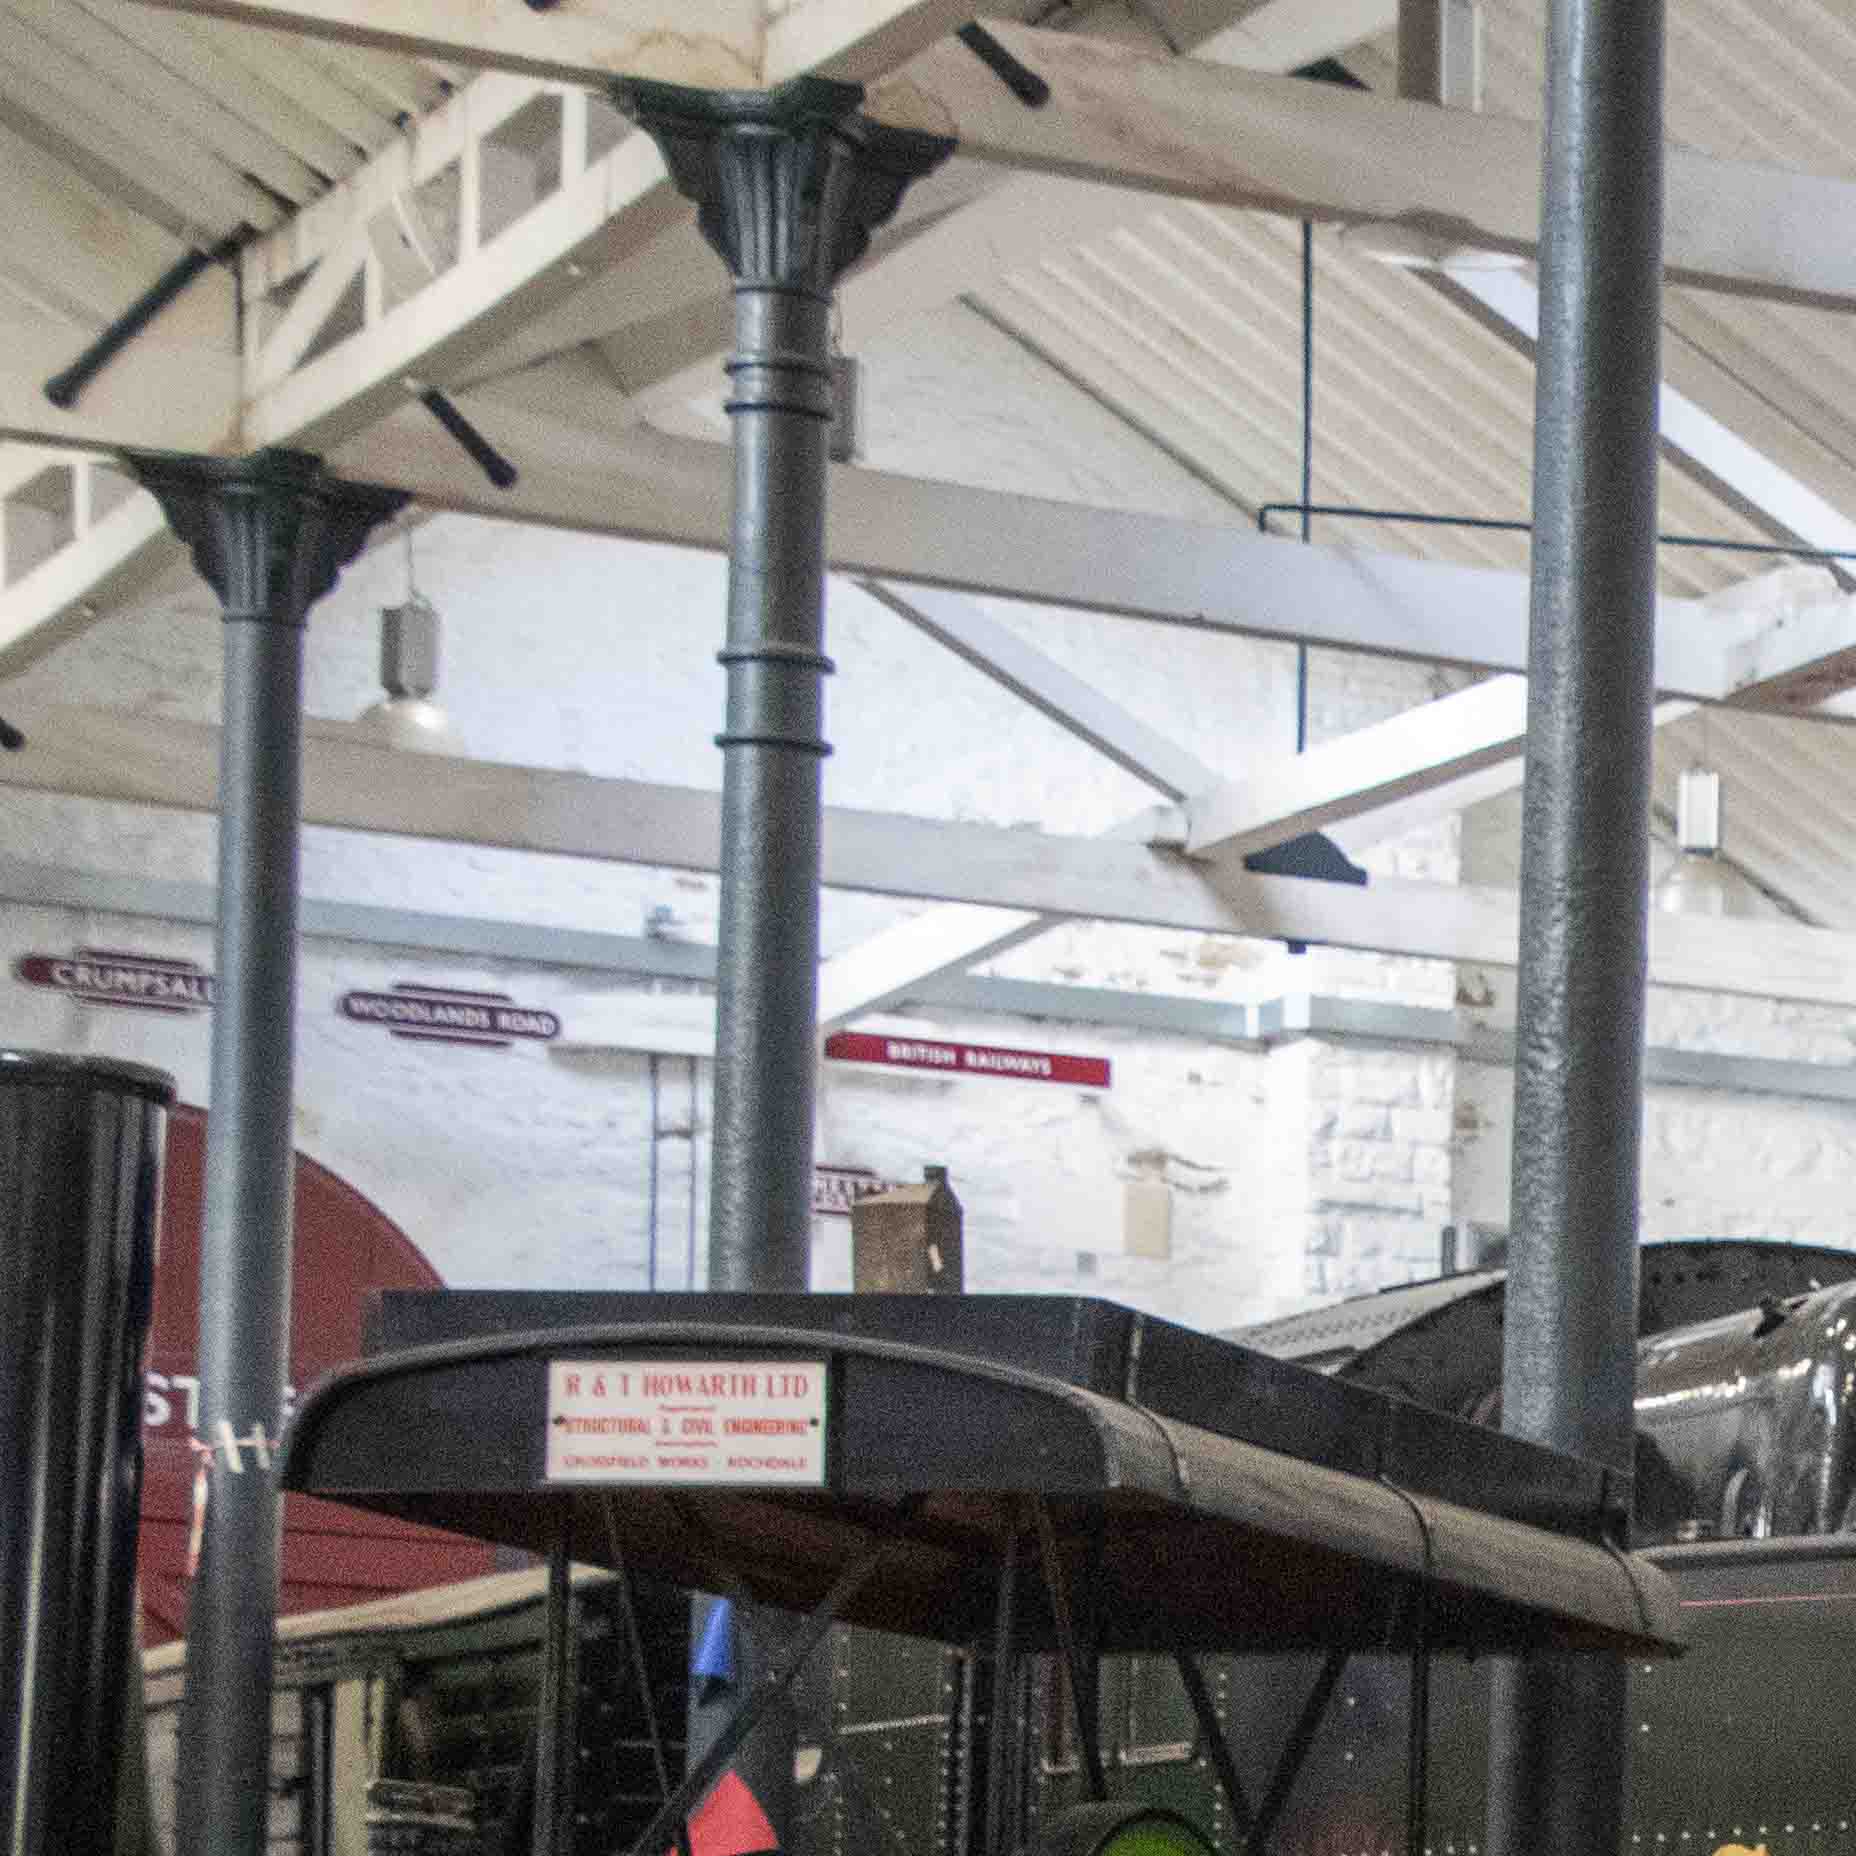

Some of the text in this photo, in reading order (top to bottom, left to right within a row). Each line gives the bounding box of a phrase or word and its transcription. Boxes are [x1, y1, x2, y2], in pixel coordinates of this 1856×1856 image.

[350, 996, 557, 1035] WOODLANDS ROAD
[886, 1040, 1052, 1075] BRITISH RAILWAYS
[564, 1373, 582, 1398] R
[642, 1373, 758, 1398] HOWARTH
[766, 1373, 809, 1399] LTD
